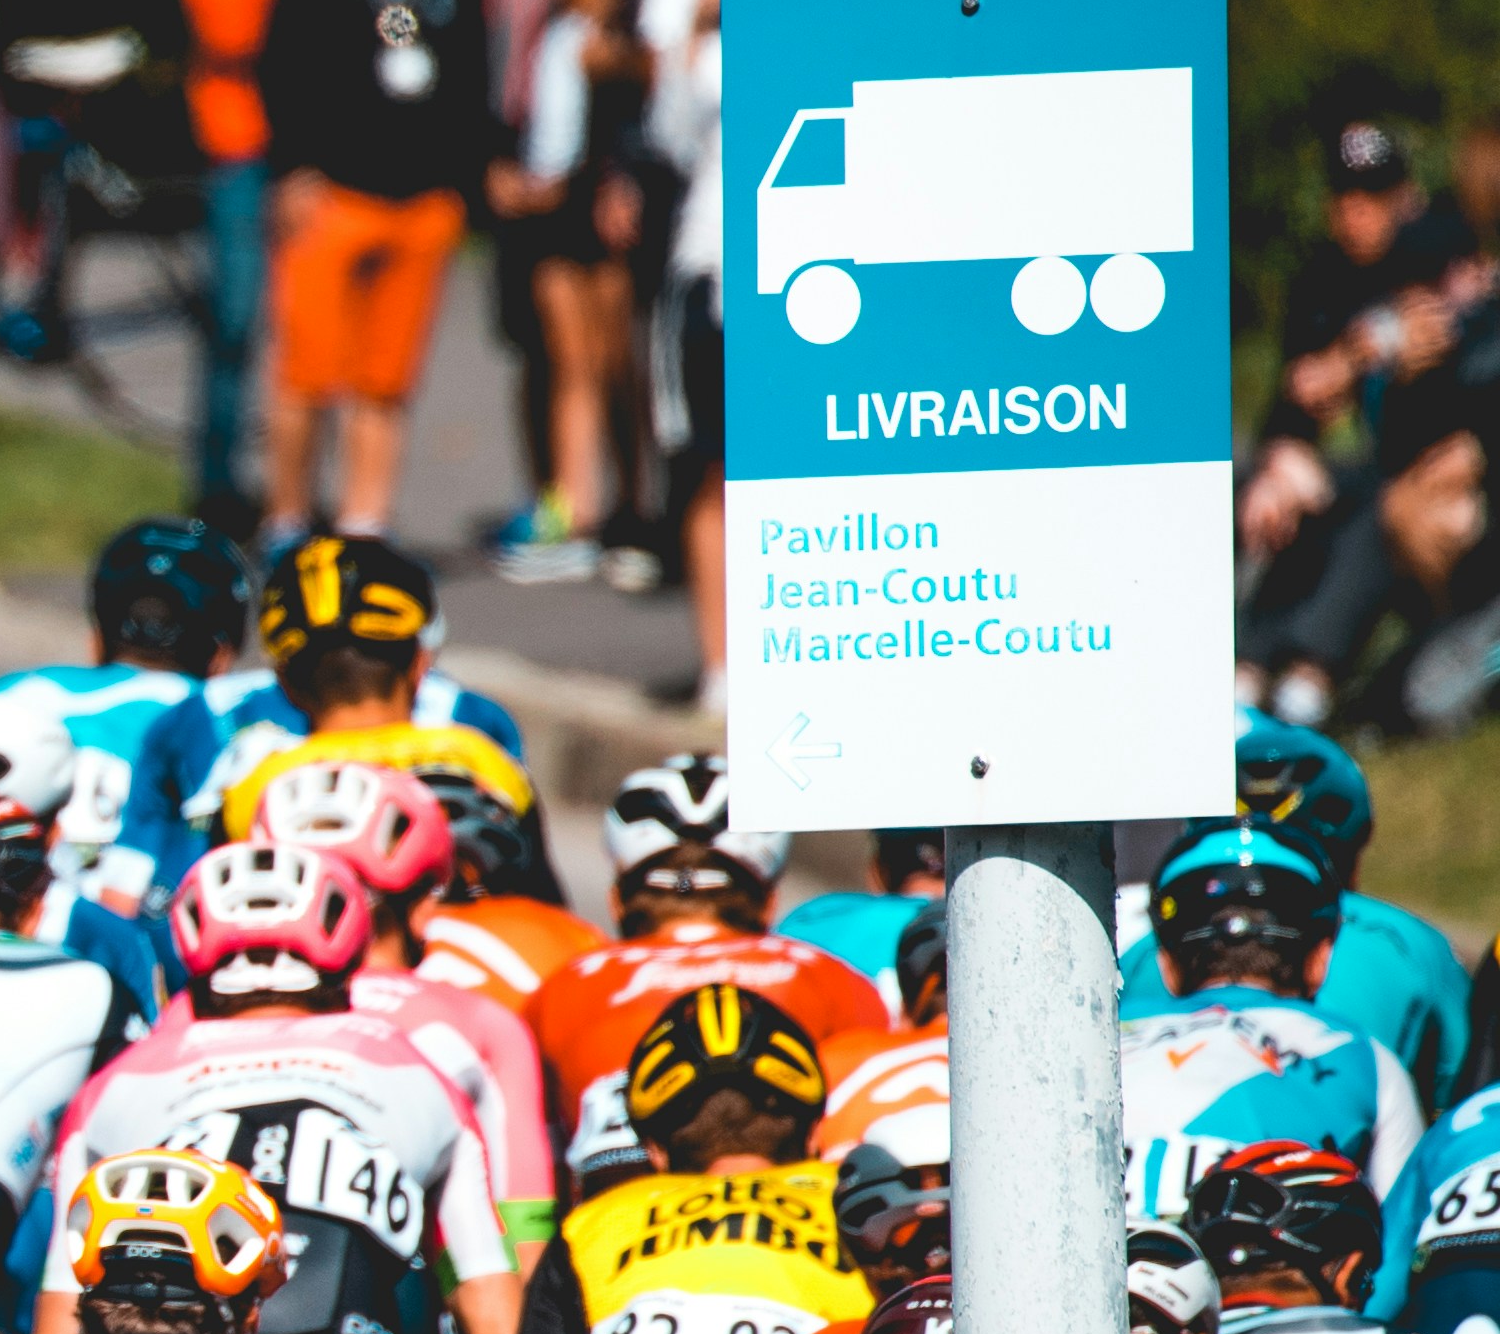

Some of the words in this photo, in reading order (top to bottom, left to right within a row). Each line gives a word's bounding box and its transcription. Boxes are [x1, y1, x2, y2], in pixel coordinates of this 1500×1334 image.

[827, 384, 1127, 440] LIVRAISON
[760, 514, 940, 555] Pavillon
[760, 568, 1018, 610] Jean-Coutu
[762, 619, 1112, 662] Marcelle-Coutu
[319, 1138, 410, 1233] 146
